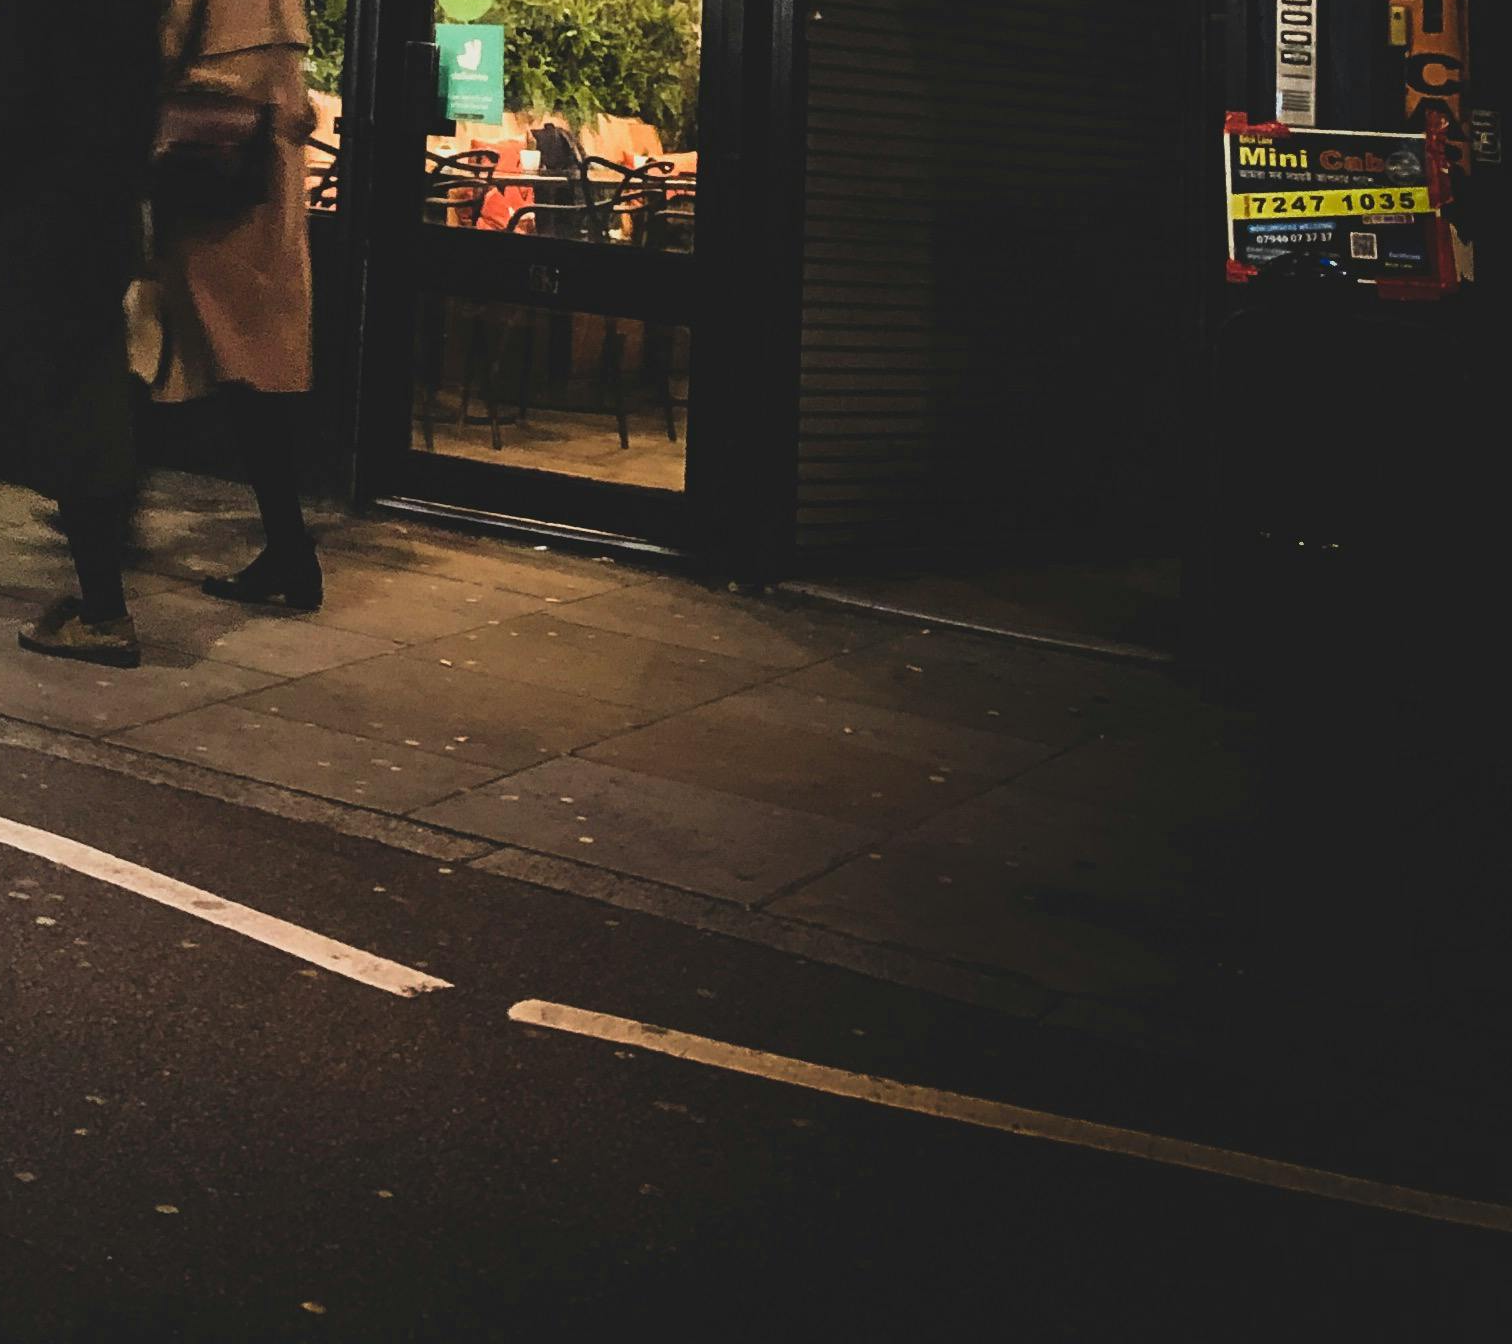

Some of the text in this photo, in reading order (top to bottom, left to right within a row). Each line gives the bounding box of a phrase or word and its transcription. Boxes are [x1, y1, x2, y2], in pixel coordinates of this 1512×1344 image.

[1239, 146, 1309, 170] Mini
[1252, 192, 1416, 213] 7247 1035
